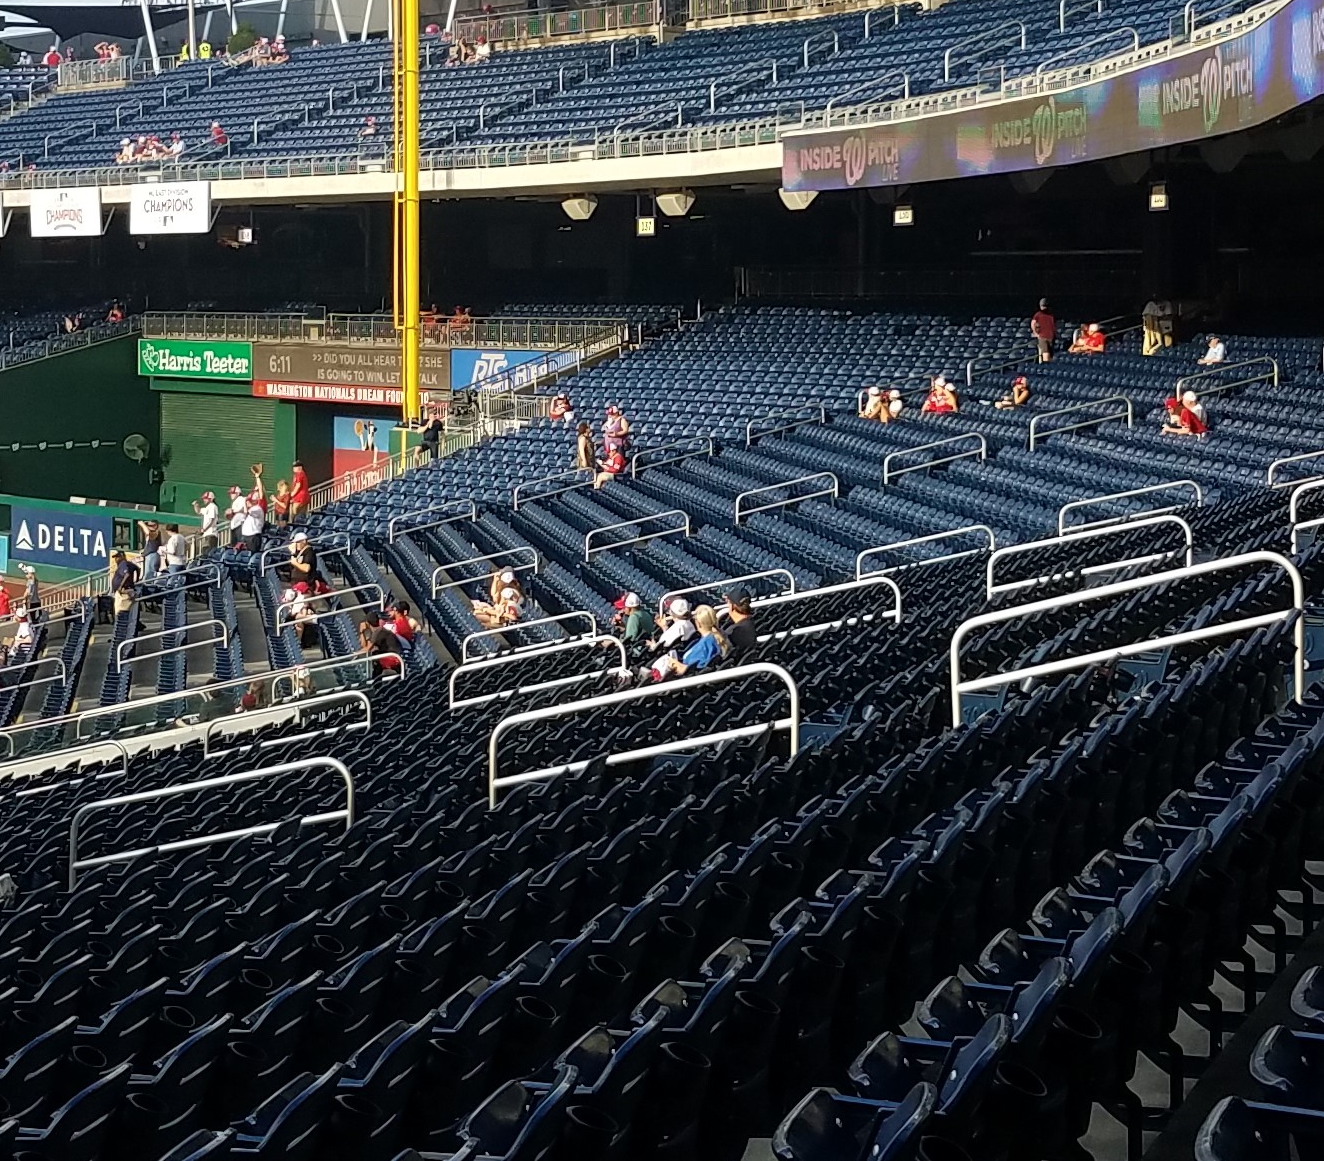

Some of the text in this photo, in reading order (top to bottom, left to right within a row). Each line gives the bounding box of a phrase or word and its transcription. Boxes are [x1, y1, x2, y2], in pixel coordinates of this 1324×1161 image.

[1162, 74, 1200, 116] INSIDE
[1224, 57, 1254, 101] PITCH
[992, 117, 1033, 149] INSIDE
[1057, 106, 1088, 139] PITCH
[800, 146, 842, 172] INSIDE
[867, 140, 900, 166] PITCH
[143, 198, 194, 214] CHAMPIONS
[46, 209, 83, 225] CHAMPIONS
[158, 348, 249, 375] Harris Teeter
[268, 354, 291, 374] 6:11
[323, 354, 337, 364] DID
[338, 354, 355, 365] YOU
[357, 355, 372, 366] ALL
[374, 356, 396, 367] HEAR
[425, 357, 443, 368] SHE
[317, 369, 325, 380] IS
[327, 370, 352, 381] GOING
[352, 371, 364, 381] TO
[267, 383, 312, 399] WASHINGTON
[314, 385, 356, 401] NATIONALS
[357, 387, 384, 403] DREAM
[37, 522, 107, 557] DELTA
